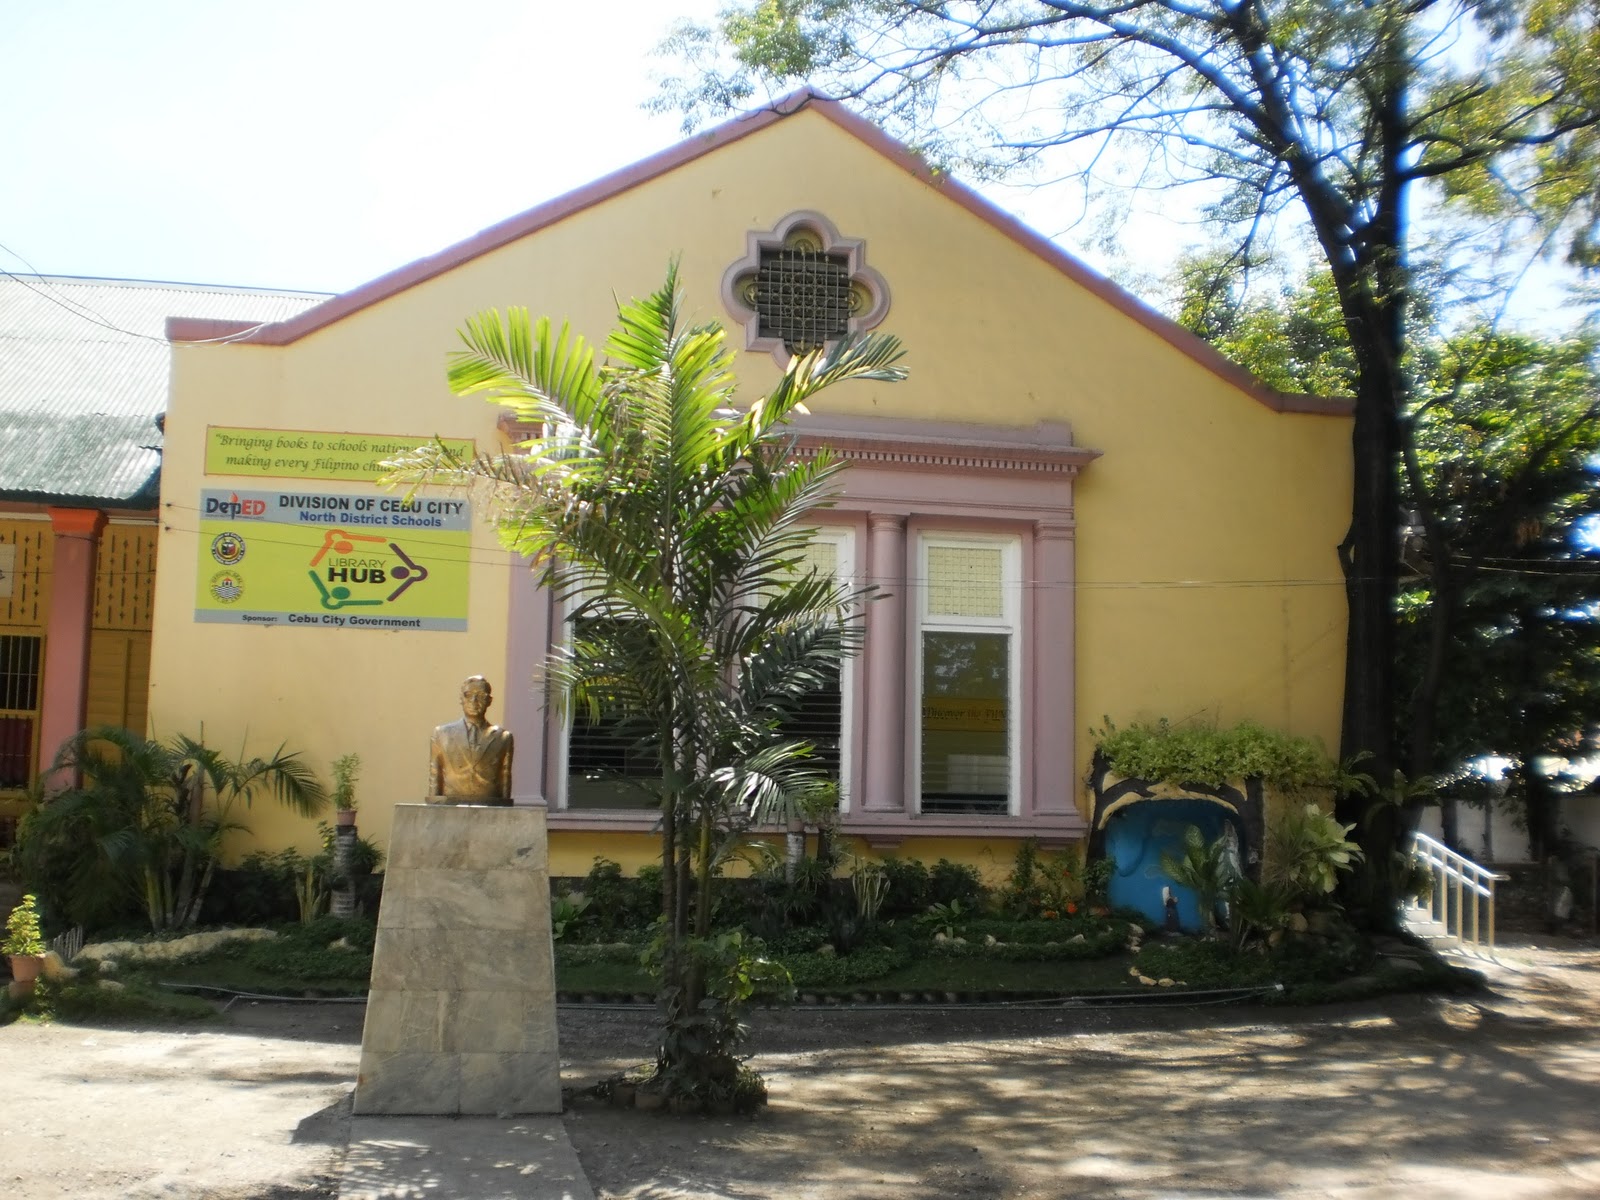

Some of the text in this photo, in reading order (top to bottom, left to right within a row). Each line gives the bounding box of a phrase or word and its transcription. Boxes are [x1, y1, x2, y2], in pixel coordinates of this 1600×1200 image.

[276, 436, 308, 449] books
[312, 440, 324, 450] to
[327, 439, 367, 452] schools
[443, 445, 466, 457] nd
[226, 454, 271, 470] making
[275, 459, 309, 472] every
[311, 458, 360, 473] Filipino
[279, 495, 349, 510] DIVISION
[354, 498, 375, 511] OF
[427, 501, 463, 515] CITY
[300, 511, 442, 527] North District Schools
[328, 558, 386, 568] LIBRARY
[328, 567, 386, 584] HUB
[242, 613, 421, 627] Sponsor: Cebu City Government
